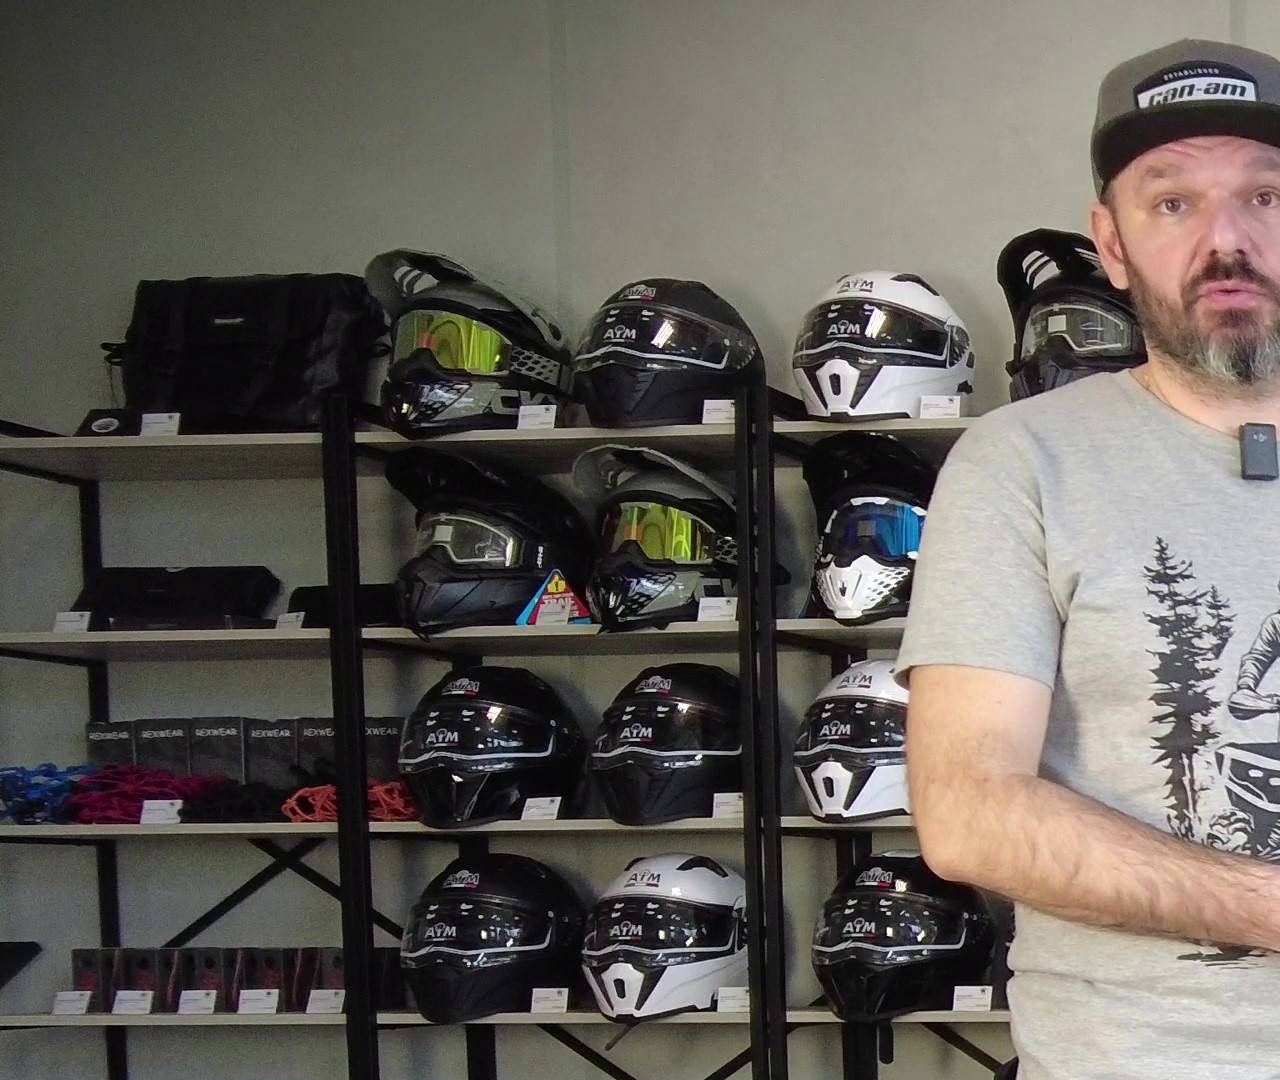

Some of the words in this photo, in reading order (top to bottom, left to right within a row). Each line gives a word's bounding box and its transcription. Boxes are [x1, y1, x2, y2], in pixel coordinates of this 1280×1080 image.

[141, 729, 184, 739] REXWEAR
[195, 727, 238, 738] REXWEAR
[251, 729, 291, 738] REXWEAR
[303, 727, 335, 738] REXWE
[364, 726, 399, 736] XWEAR
